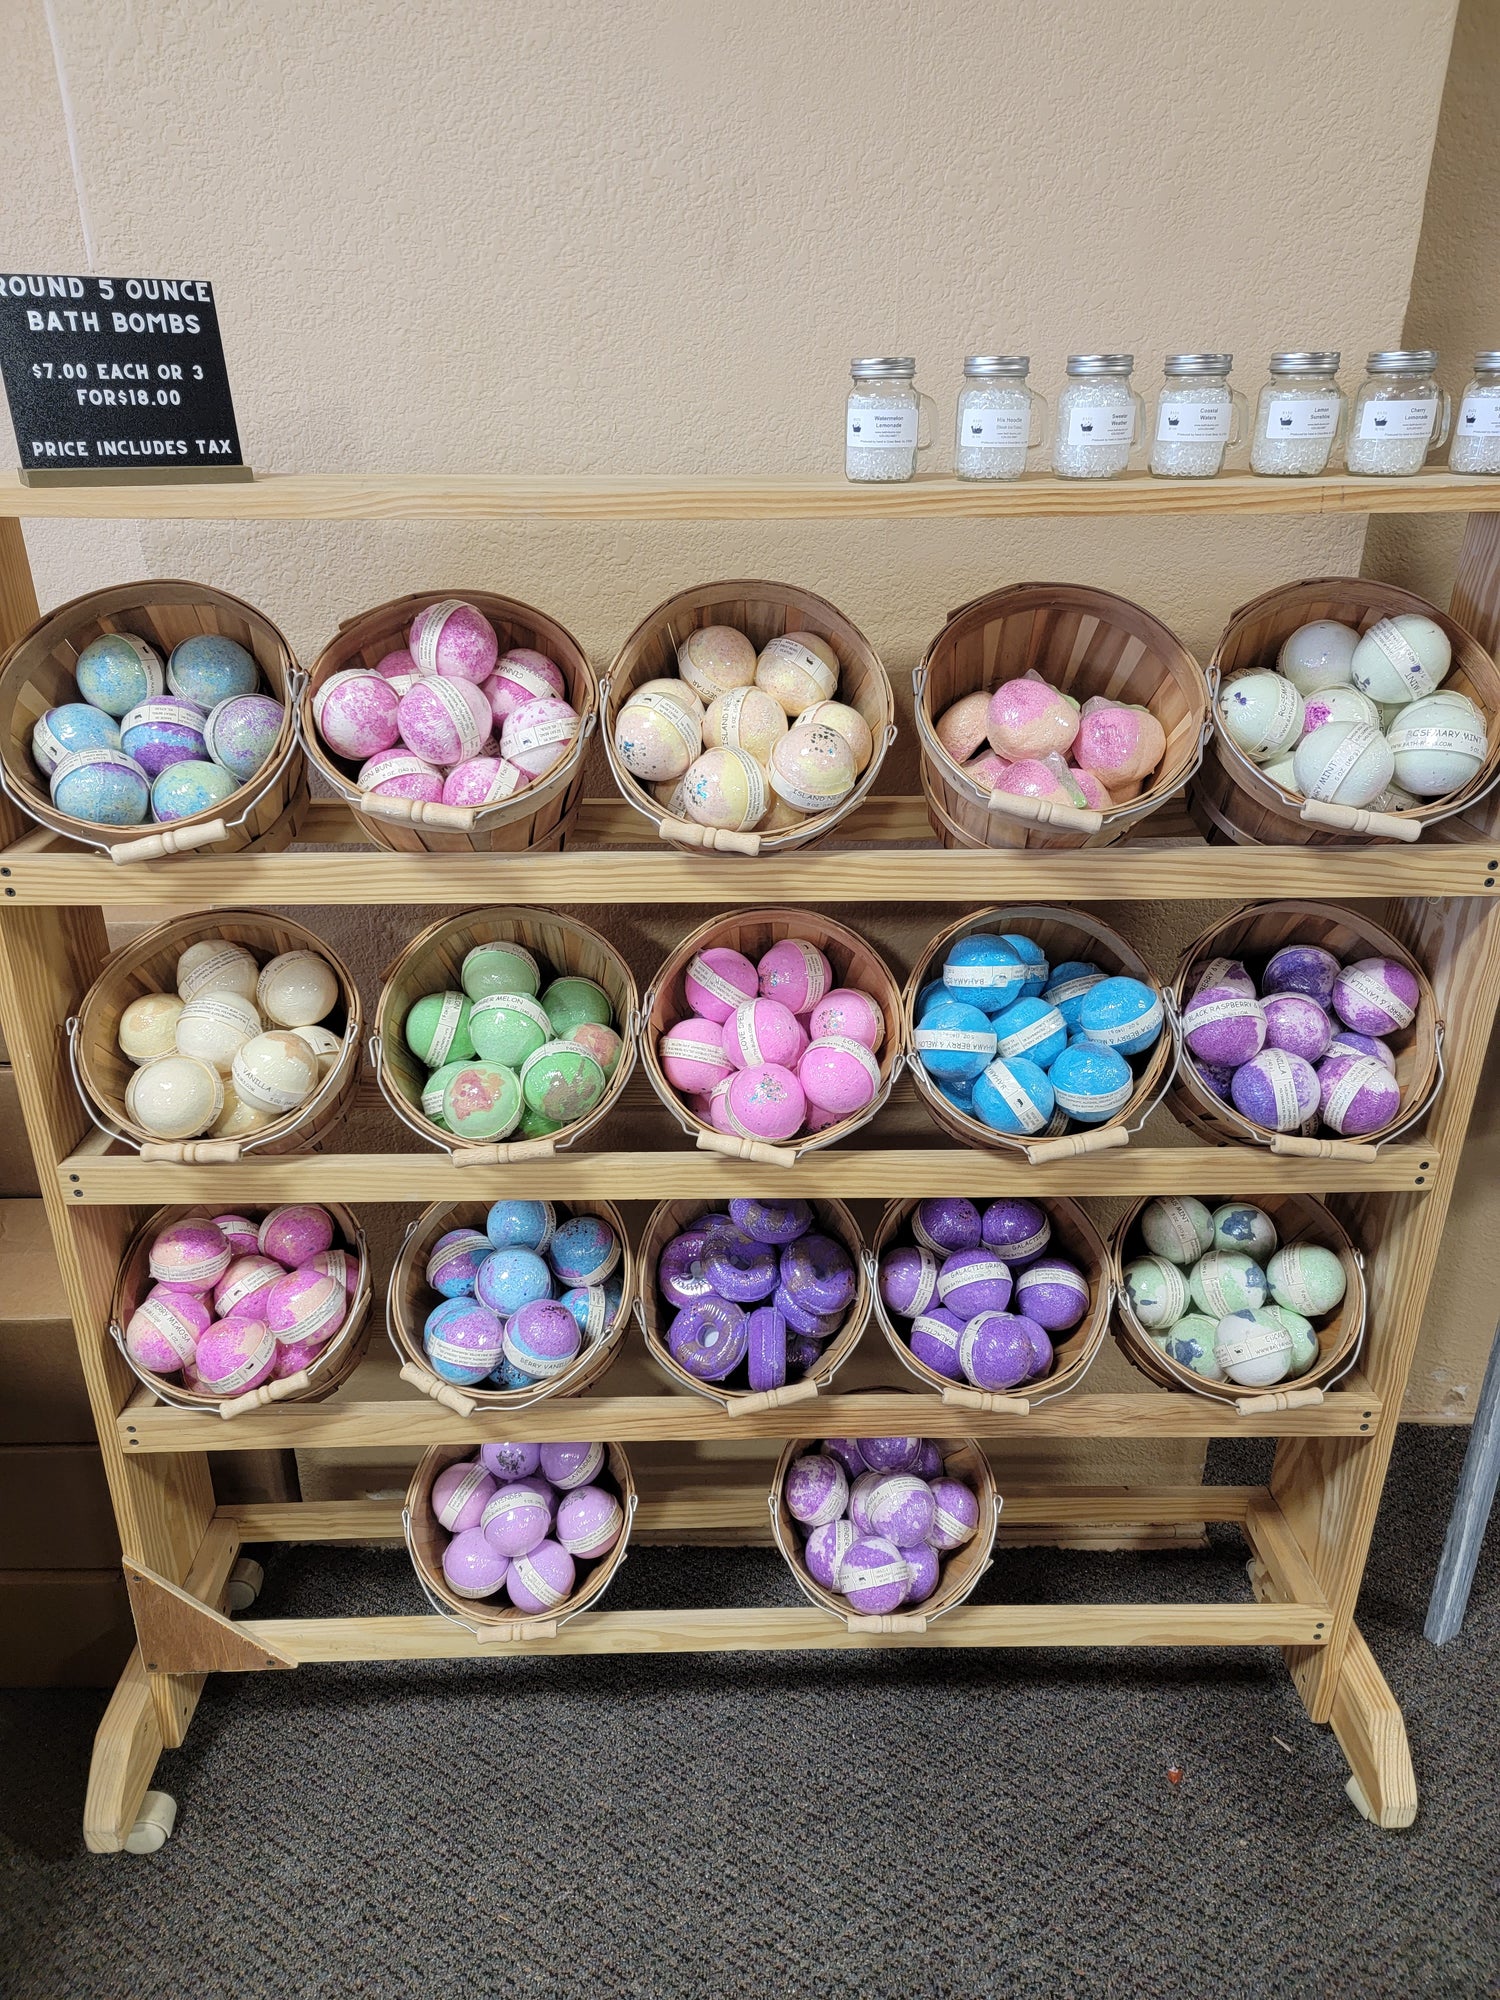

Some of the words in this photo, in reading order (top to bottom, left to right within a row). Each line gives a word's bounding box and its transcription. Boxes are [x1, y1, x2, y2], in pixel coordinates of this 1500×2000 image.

[100, 280, 115, 300] 5
[125, 280, 211, 302] OUNCE
[26, 310, 100, 332] BATH
[112, 312, 200, 334] BOMBS
[32, 363, 88, 378] $7.00
[97, 364, 149, 380] EACH
[158, 365, 183, 380] OR
[192, 366, 204, 380] 3
[76, 389, 180, 406] FOR$18.00
[32, 441, 89, 456] PRICE
[98, 440, 188, 456] INCLUDES
[196, 440, 232, 454] TAX
[375, 762, 393, 774] BUN
[1318, 760, 1338, 786] MINT
[793, 789, 825, 801] ISLAND
[1351, 978, 1379, 1000] VANILLA
[496, 996, 523, 1005] MELON
[1188, 1009, 1209, 1022] BLACK
[1210, 1002, 1252, 1012] RASPBERRY
[739, 1031, 748, 1050] LOVE
[842, 1038, 860, 1049] LOVE
[1118, 1032, 1139, 1043] BERRY
[243, 1067, 272, 1093] VANILLA
[1177, 1206, 1189, 1223] MINT
[950, 1265, 984, 1279] GALACTIC
[168, 1317, 190, 1342] MIMOSA
[925, 1327, 954, 1346] GALACTIC
[520, 1358, 542, 1368] BERRY
[568, 1454, 592, 1481] LAVENDER
[490, 1493, 522, 1509] LAVENDER
